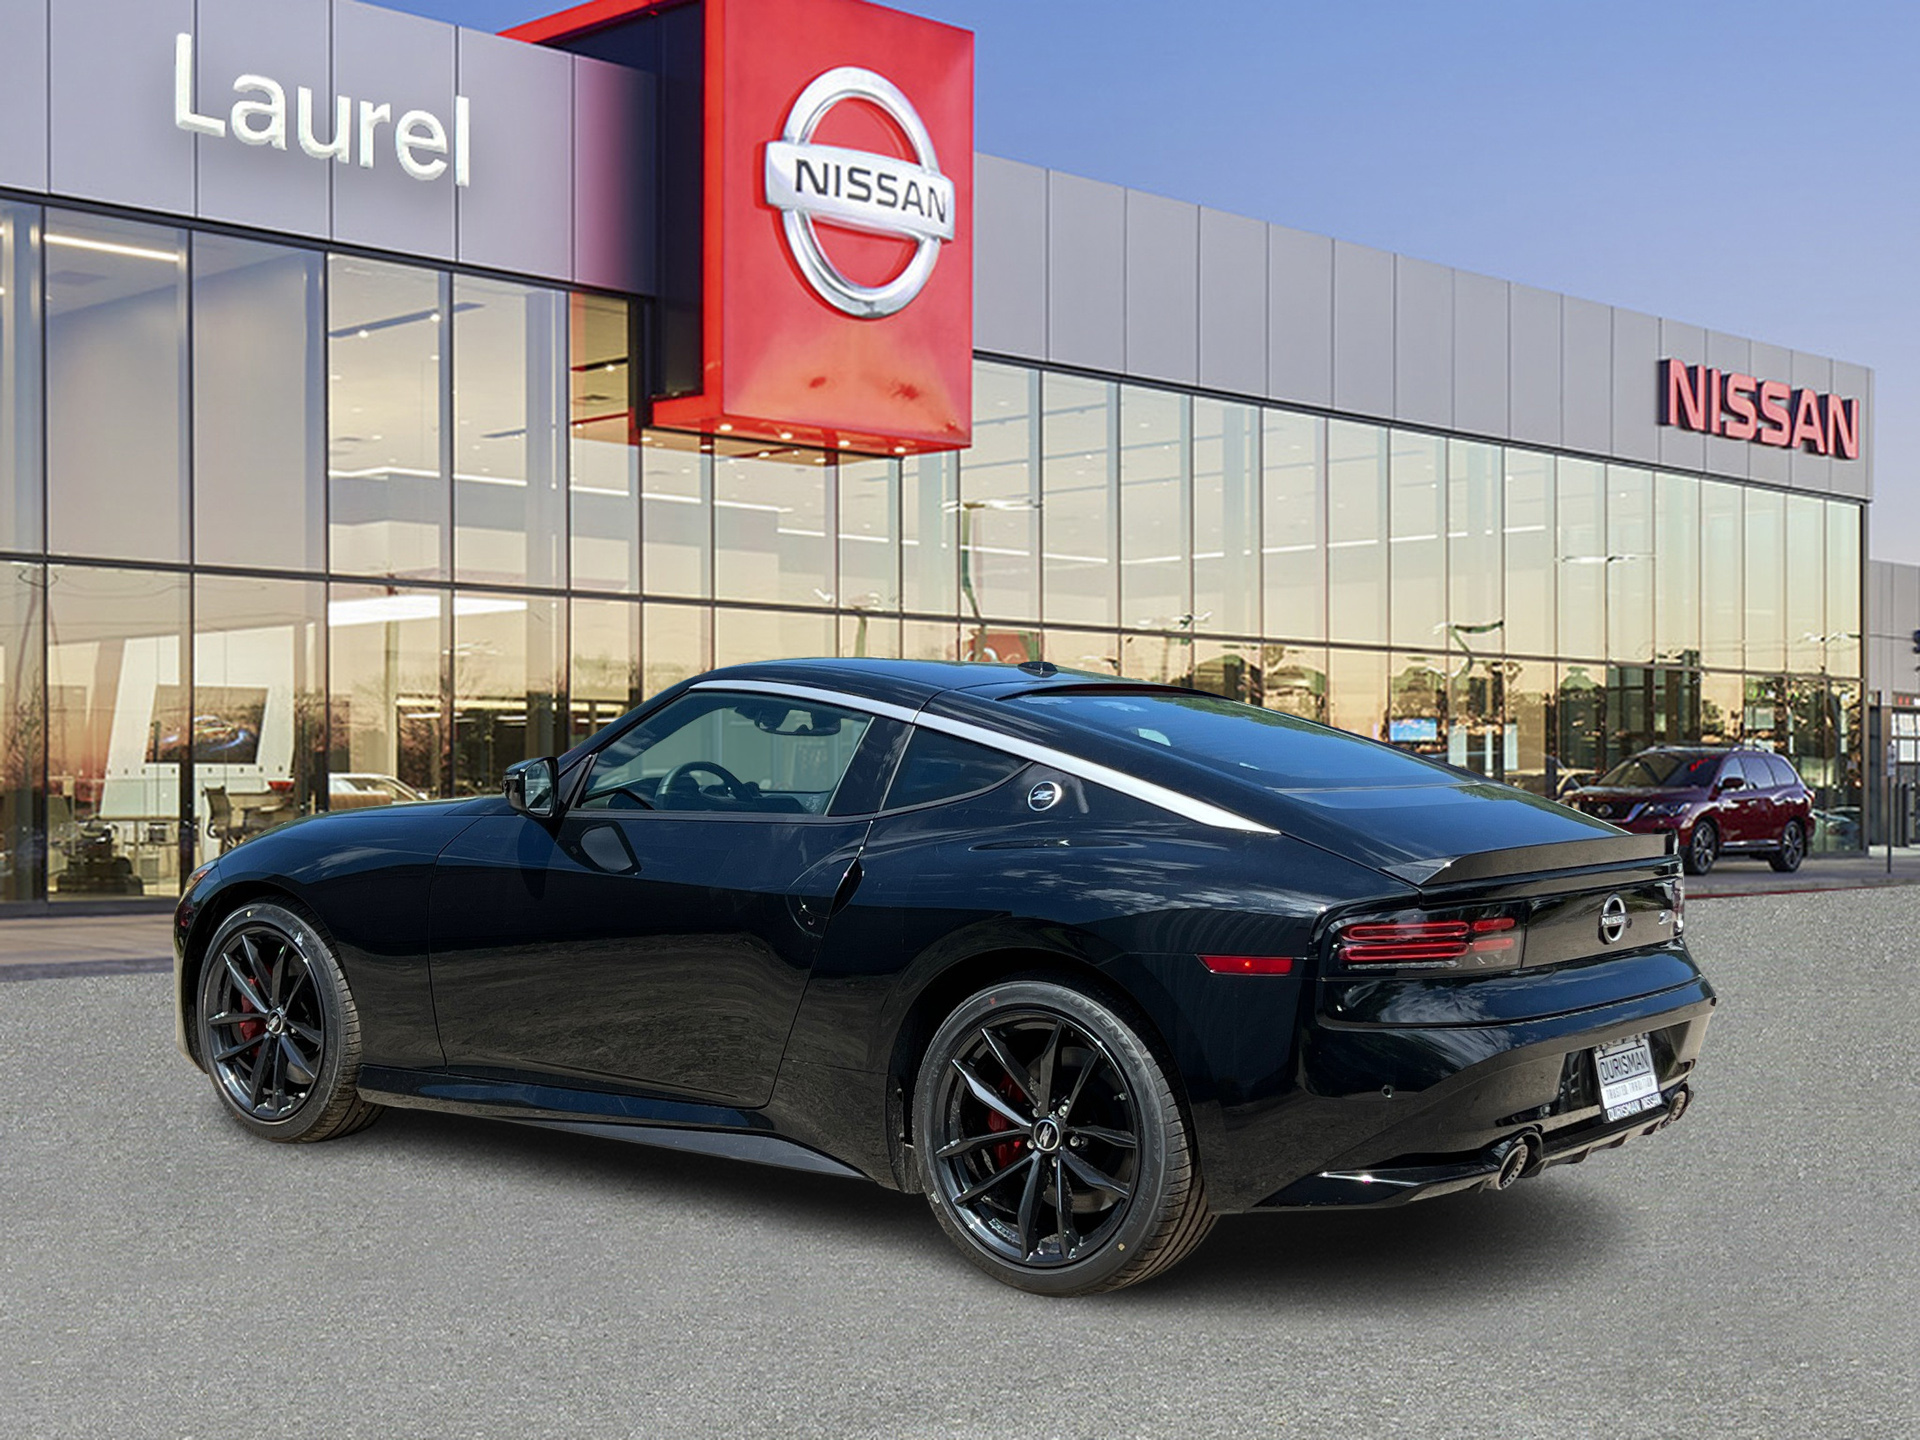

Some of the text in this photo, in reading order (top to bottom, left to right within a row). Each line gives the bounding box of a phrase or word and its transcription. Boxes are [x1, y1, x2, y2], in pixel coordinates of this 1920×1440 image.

[174, 32, 471, 188] Laurel
[794, 157, 948, 225] NISSAN
[1659, 358, 1860, 460] NISSAN
[1600, 1050, 1651, 1080] OURISMAN
